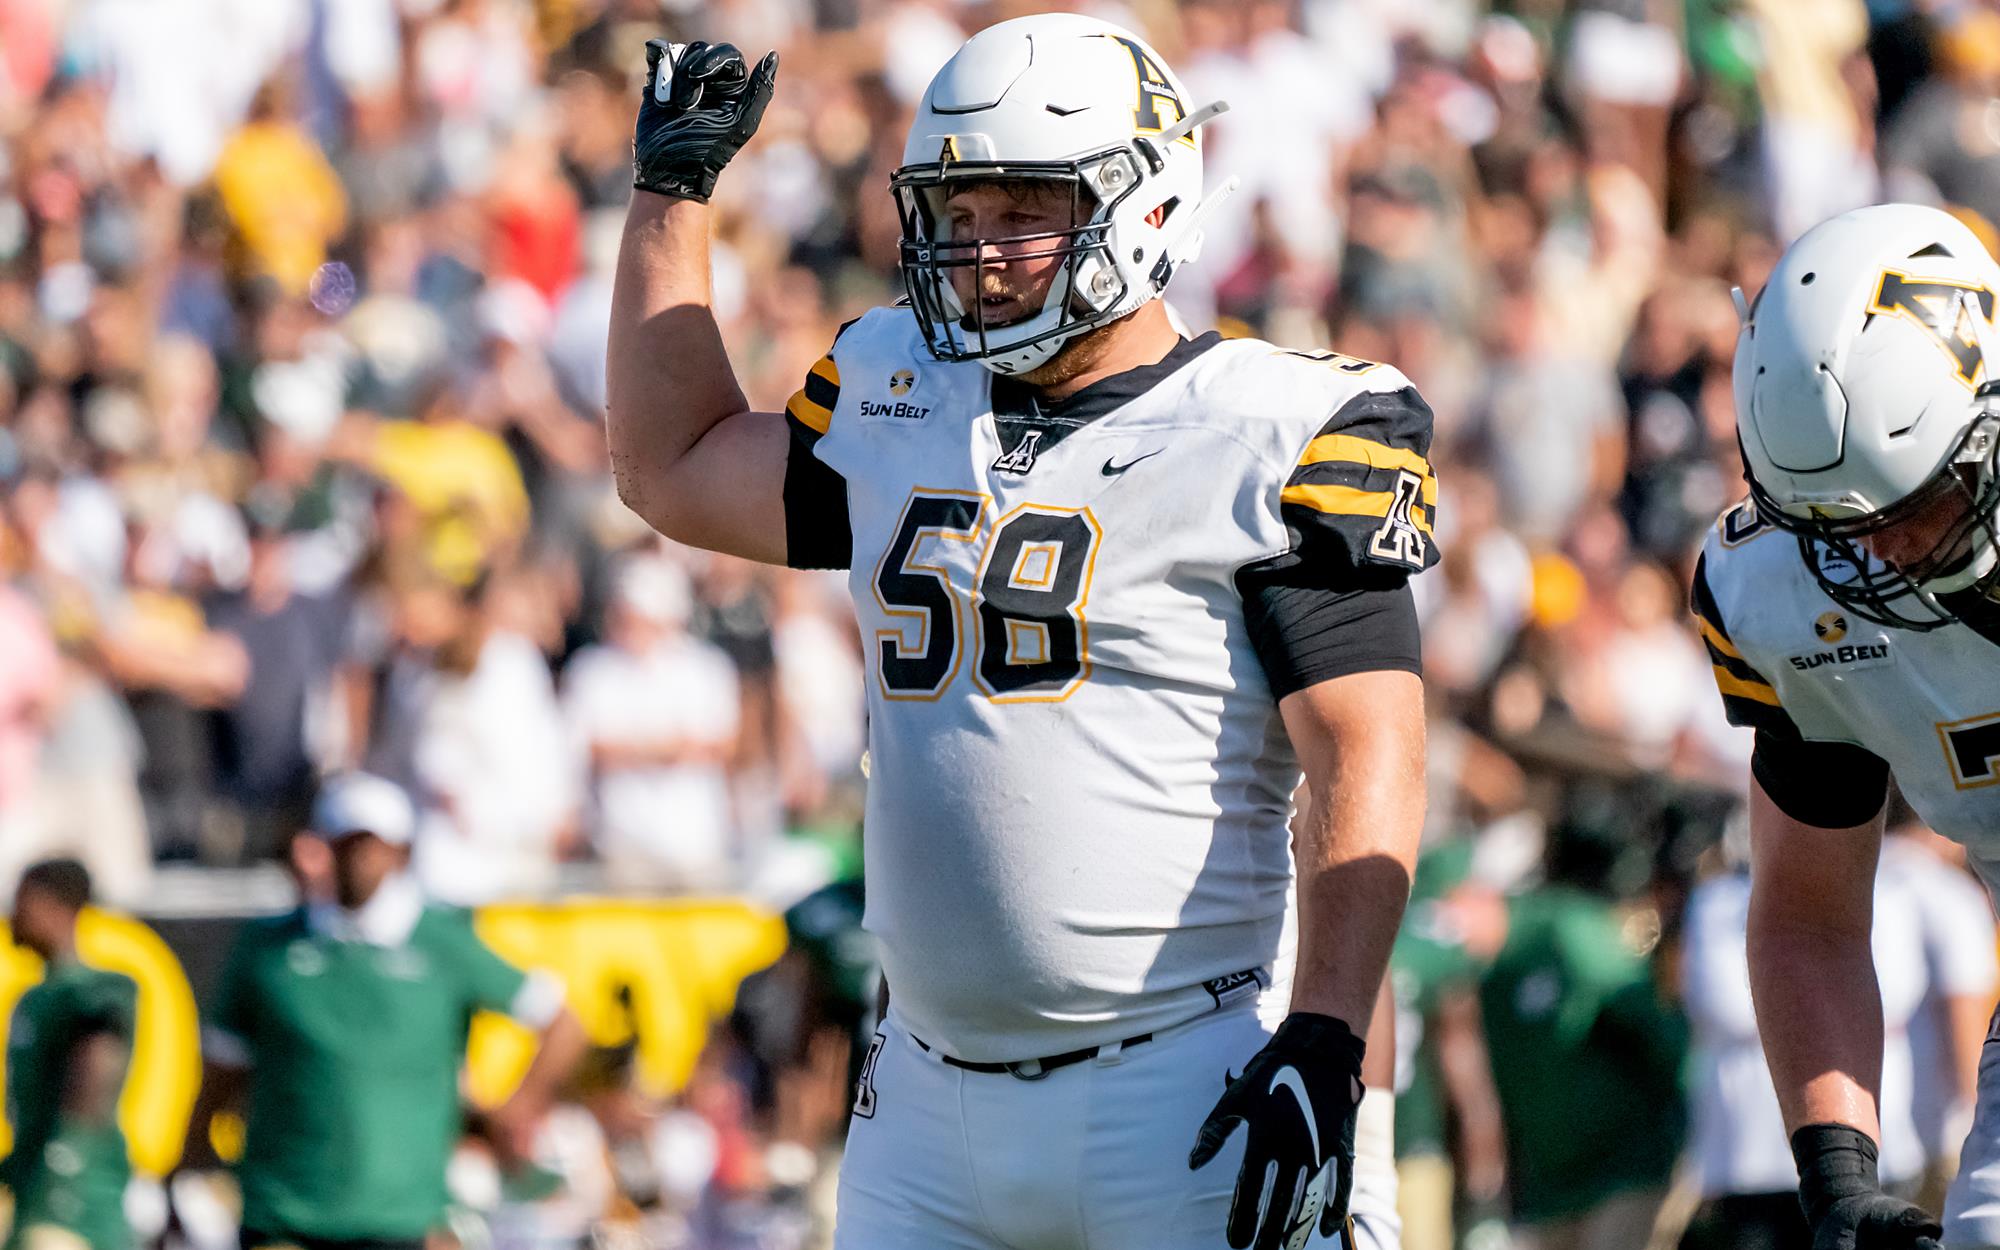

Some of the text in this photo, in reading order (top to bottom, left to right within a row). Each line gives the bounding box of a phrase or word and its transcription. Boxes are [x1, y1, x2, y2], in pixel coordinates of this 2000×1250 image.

[1110, 35, 1197, 150] A
[939, 135, 960, 162] A
[860, 401, 931, 420] SUN BELT
[1366, 468, 1425, 571] A
[871, 486, 1104, 704] 58
[1790, 644, 1889, 671] SUN BELT
